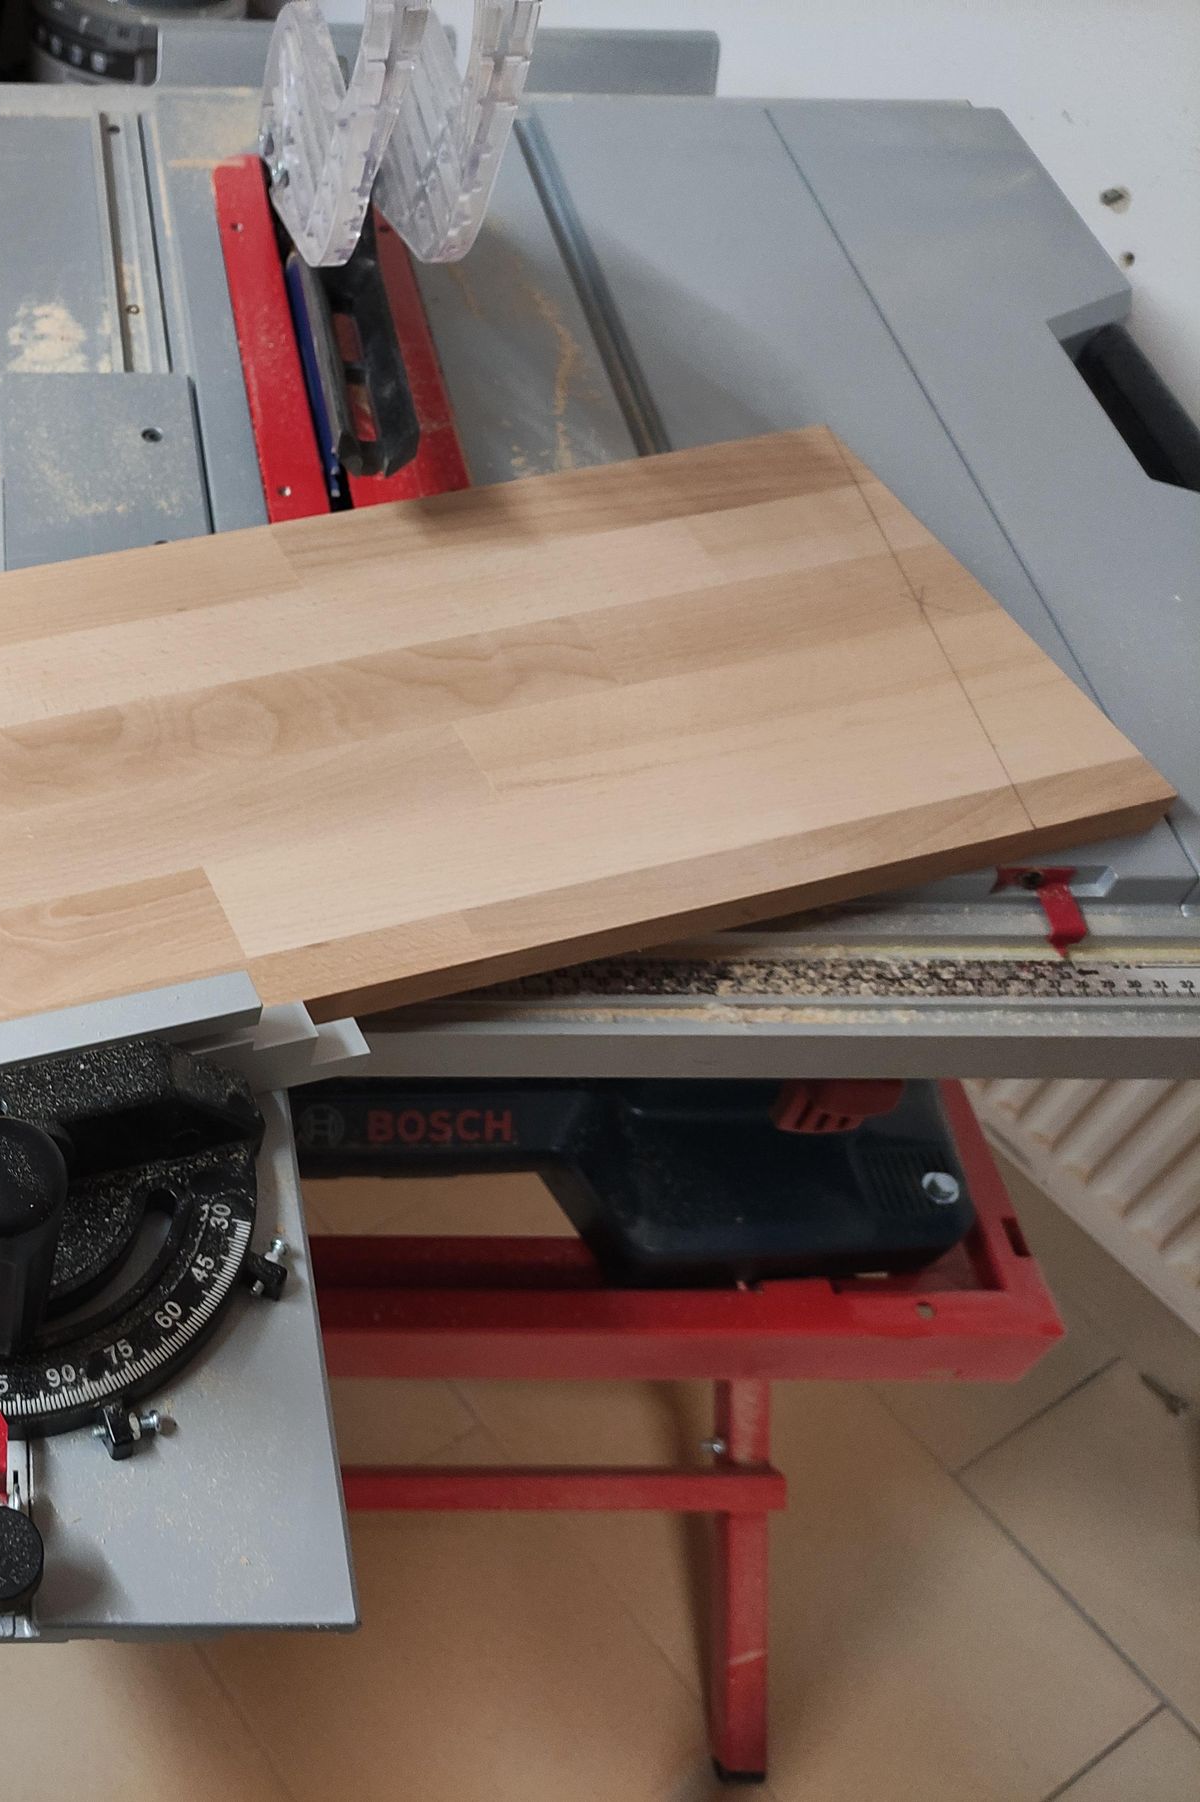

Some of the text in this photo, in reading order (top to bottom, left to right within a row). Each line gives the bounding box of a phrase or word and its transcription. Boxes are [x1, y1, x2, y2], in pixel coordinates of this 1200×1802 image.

[366, 1109, 513, 1142] BOSCH
[45, 1364, 76, 1388] 90
[103, 1338, 134, 1365] 75
[154, 1301, 182, 1329] 60
[191, 1253, 215, 1283] 45
[210, 1203, 232, 1230] 30
